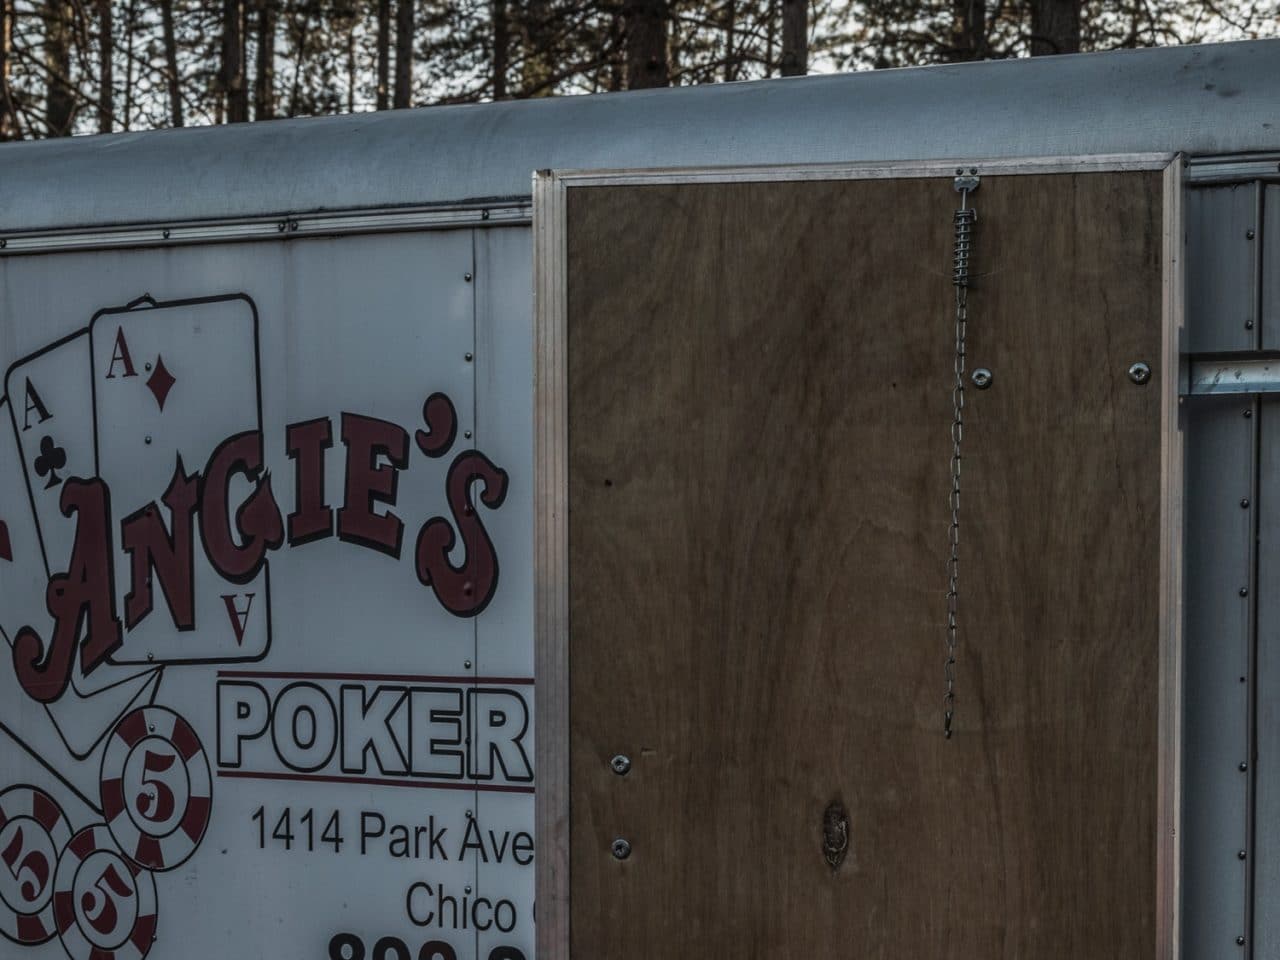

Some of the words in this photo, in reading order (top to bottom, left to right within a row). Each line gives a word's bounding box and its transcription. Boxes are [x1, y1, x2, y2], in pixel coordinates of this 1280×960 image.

[105, 325, 138, 379] A
[22, 376, 53, 431] A
[13, 392, 509, 701] ANGIE'S
[220, 593, 256, 648] A
[216, 680, 534, 782] POKER
[136, 750, 176, 823] 5
[251, 805, 344, 853] 1414
[360, 811, 448, 862] Park
[406, 881, 517, 933] Chico
